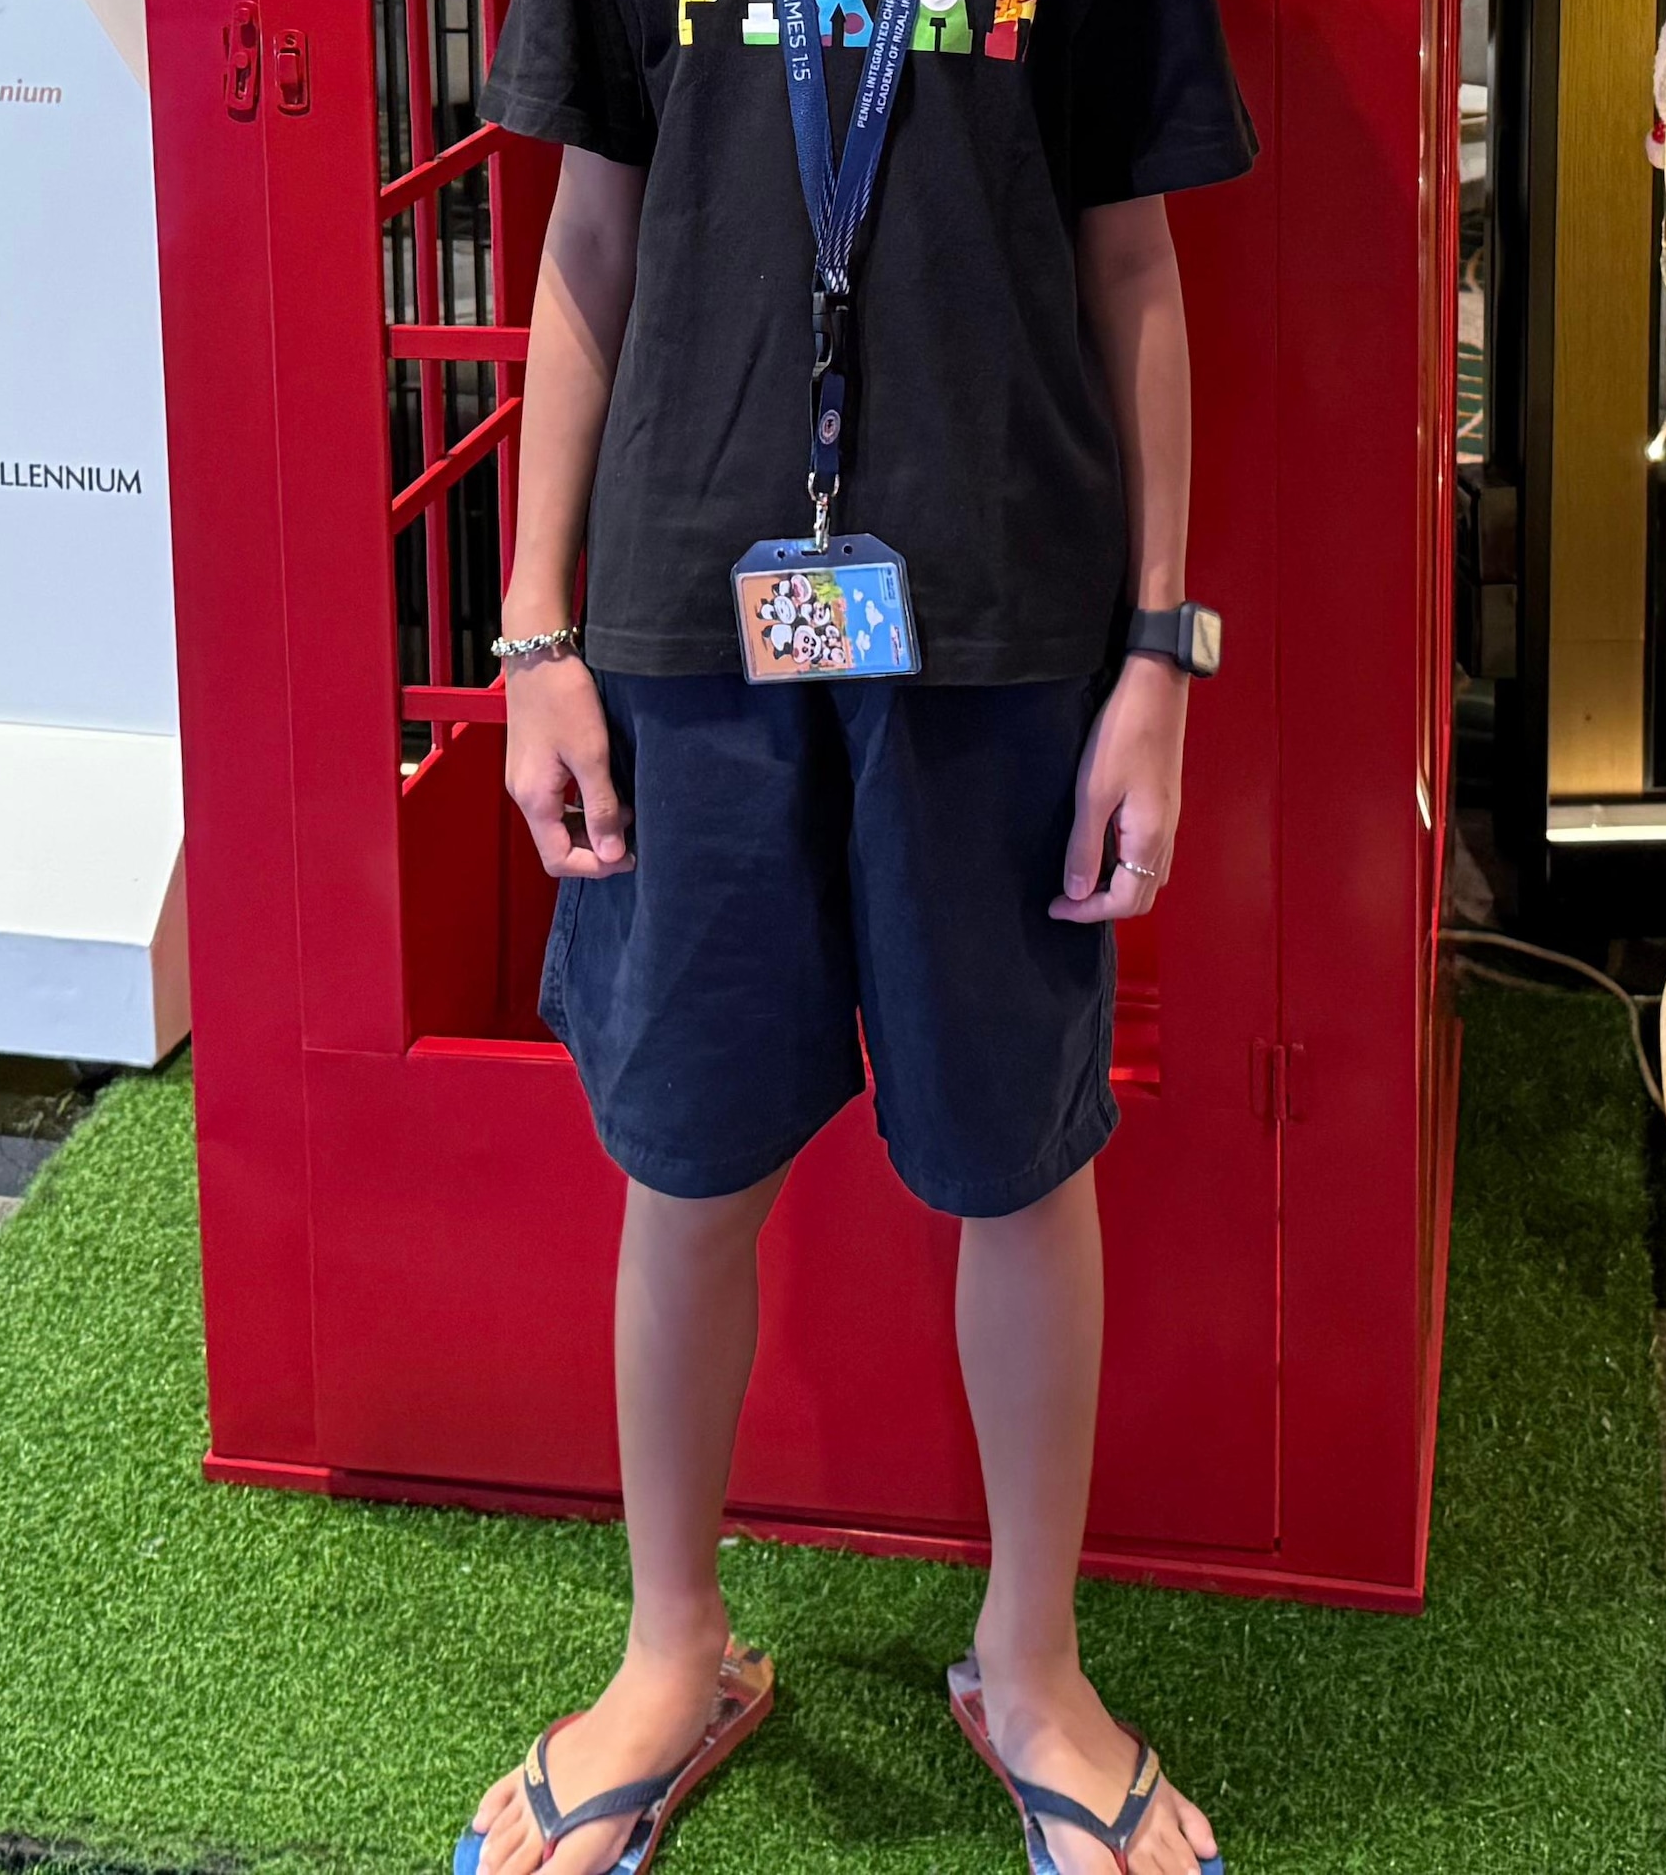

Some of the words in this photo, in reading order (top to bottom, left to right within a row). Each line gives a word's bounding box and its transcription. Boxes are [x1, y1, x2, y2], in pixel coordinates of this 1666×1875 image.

[790, 53, 811, 82] 1:5
[865, 21, 890, 90] INTEGRATED
[875, 60, 896, 114] ACADEMY
[888, 43, 900, 60] OF
[857, 86, 874, 129] PENIEL
